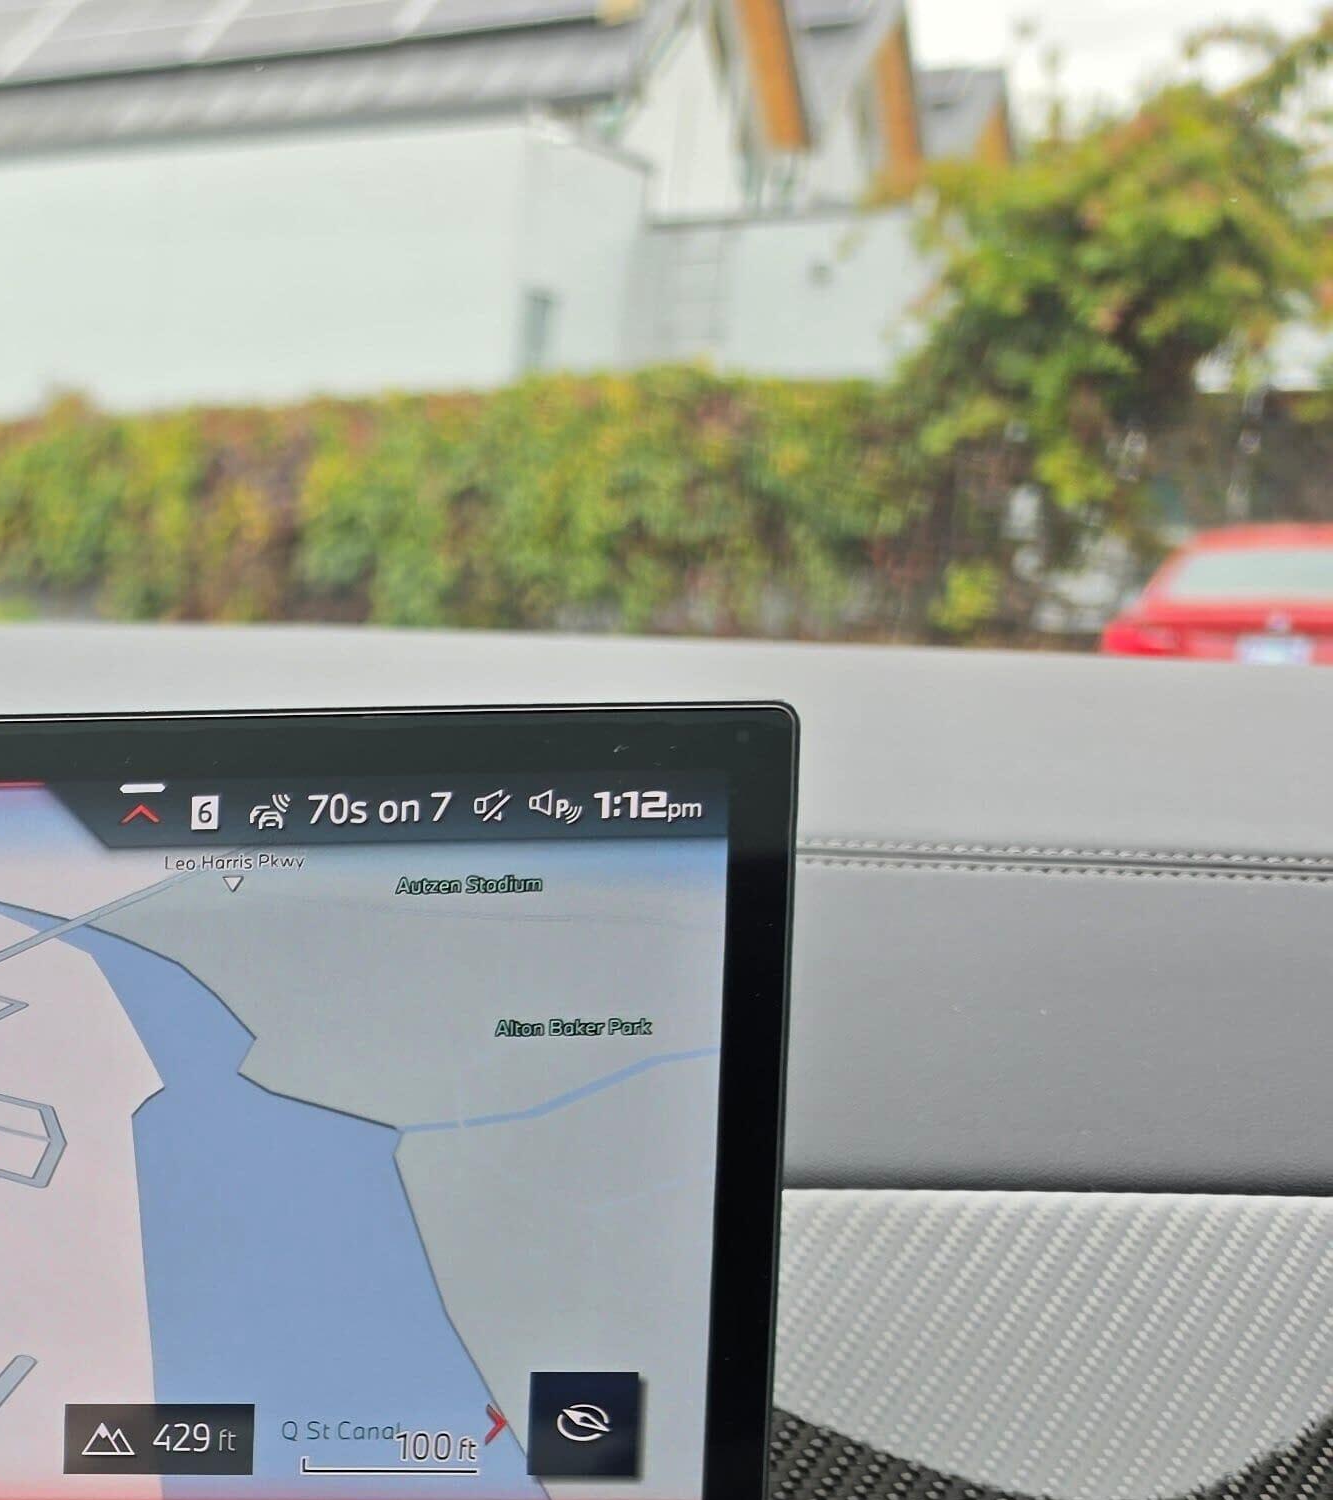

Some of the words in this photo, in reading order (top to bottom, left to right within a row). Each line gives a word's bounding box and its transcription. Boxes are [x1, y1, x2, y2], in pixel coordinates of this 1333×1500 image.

[307, 794, 368, 825] 70s
[378, 799, 421, 823] on
[430, 791, 453, 822] 7
[164, 854, 197, 871] Leo
[201, 853, 253, 870] Harris
[258, 851, 305, 870] Pkwy
[395, 876, 463, 895] Autzen
[465, 874, 543, 894] Stadium
[495, 1019, 544, 1037] Alton
[548, 1018, 604, 1037] Baker
[608, 1018, 653, 1036] Park
[152, 1423, 210, 1453] 429
[219, 1429, 237, 1451] ft
[281, 1421, 298, 1441] Q
[307, 1420, 330, 1440] St
[396, 1432, 451, 1461] 100
[457, 1438, 478, 1460] ft
